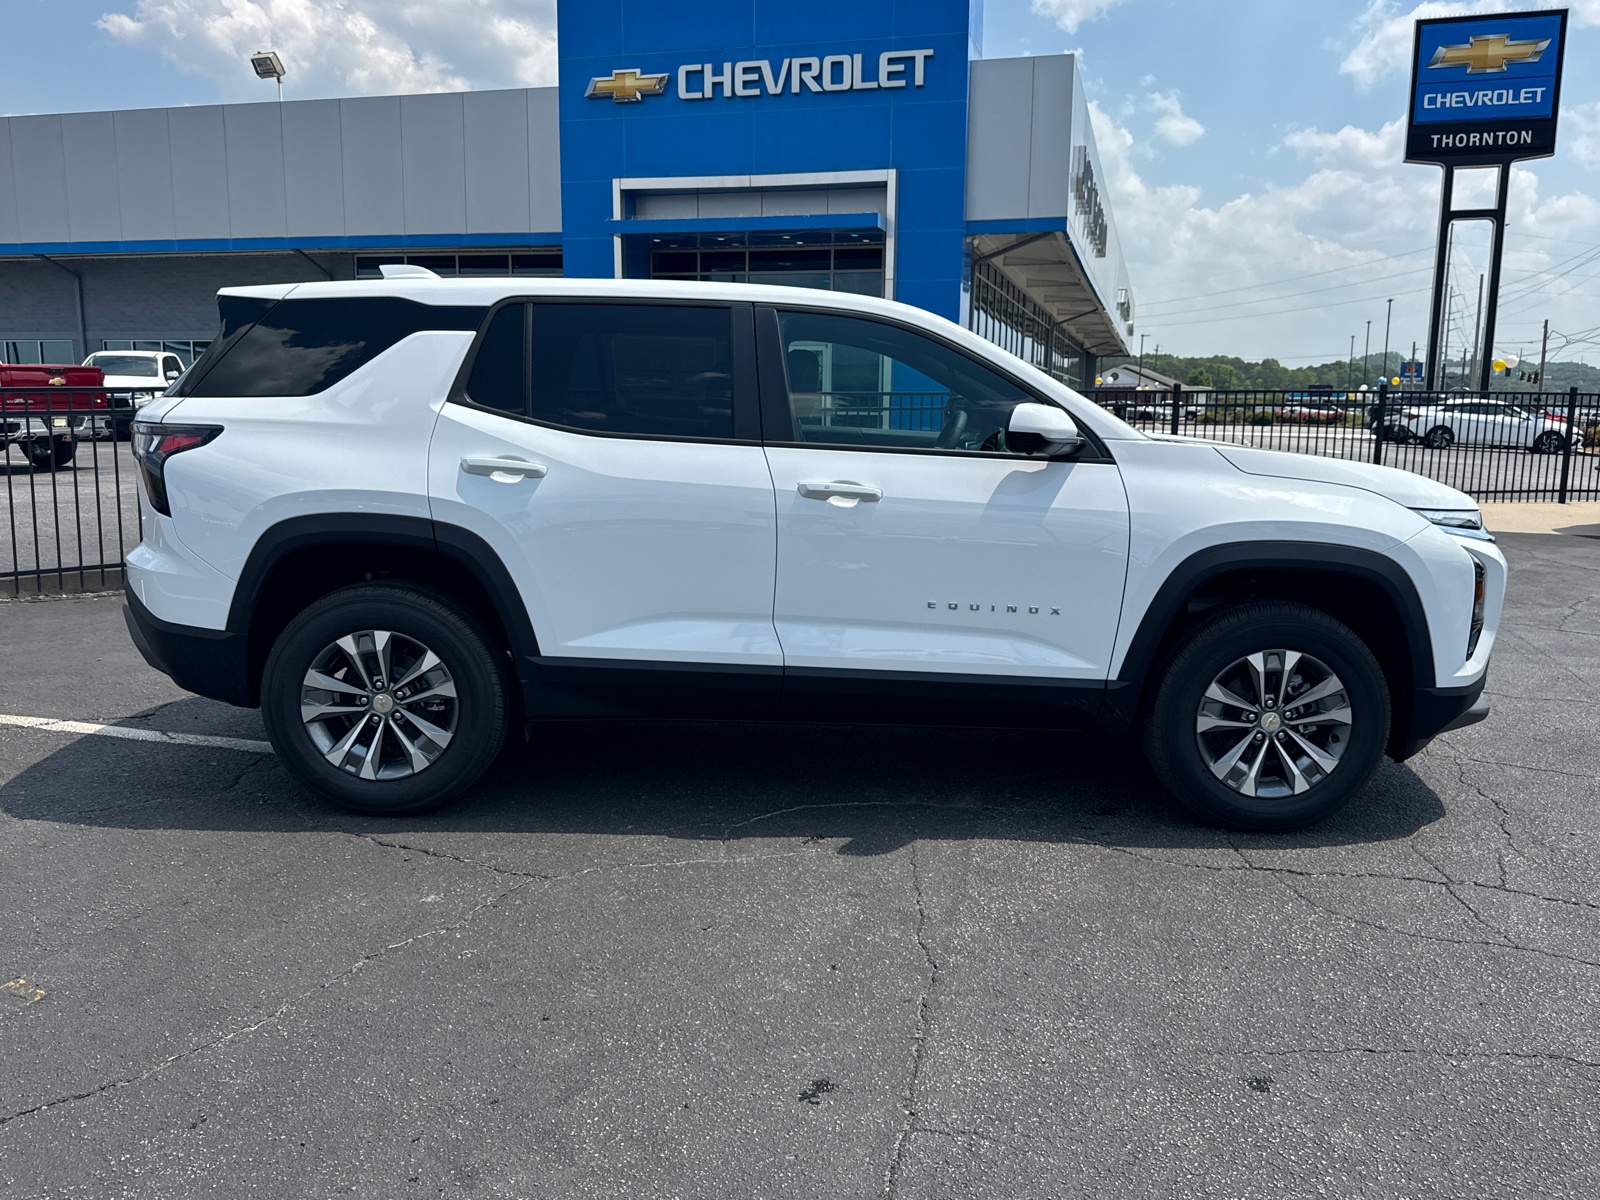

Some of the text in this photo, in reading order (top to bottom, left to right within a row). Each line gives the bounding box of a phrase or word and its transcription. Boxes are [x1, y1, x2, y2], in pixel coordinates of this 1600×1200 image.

[677, 48, 934, 100] CHEVROLET
[1423, 87, 1546, 109] CHEVROLET
[1431, 130, 1533, 149] THORNTON
[927, 600, 1062, 616] EQUINOX
